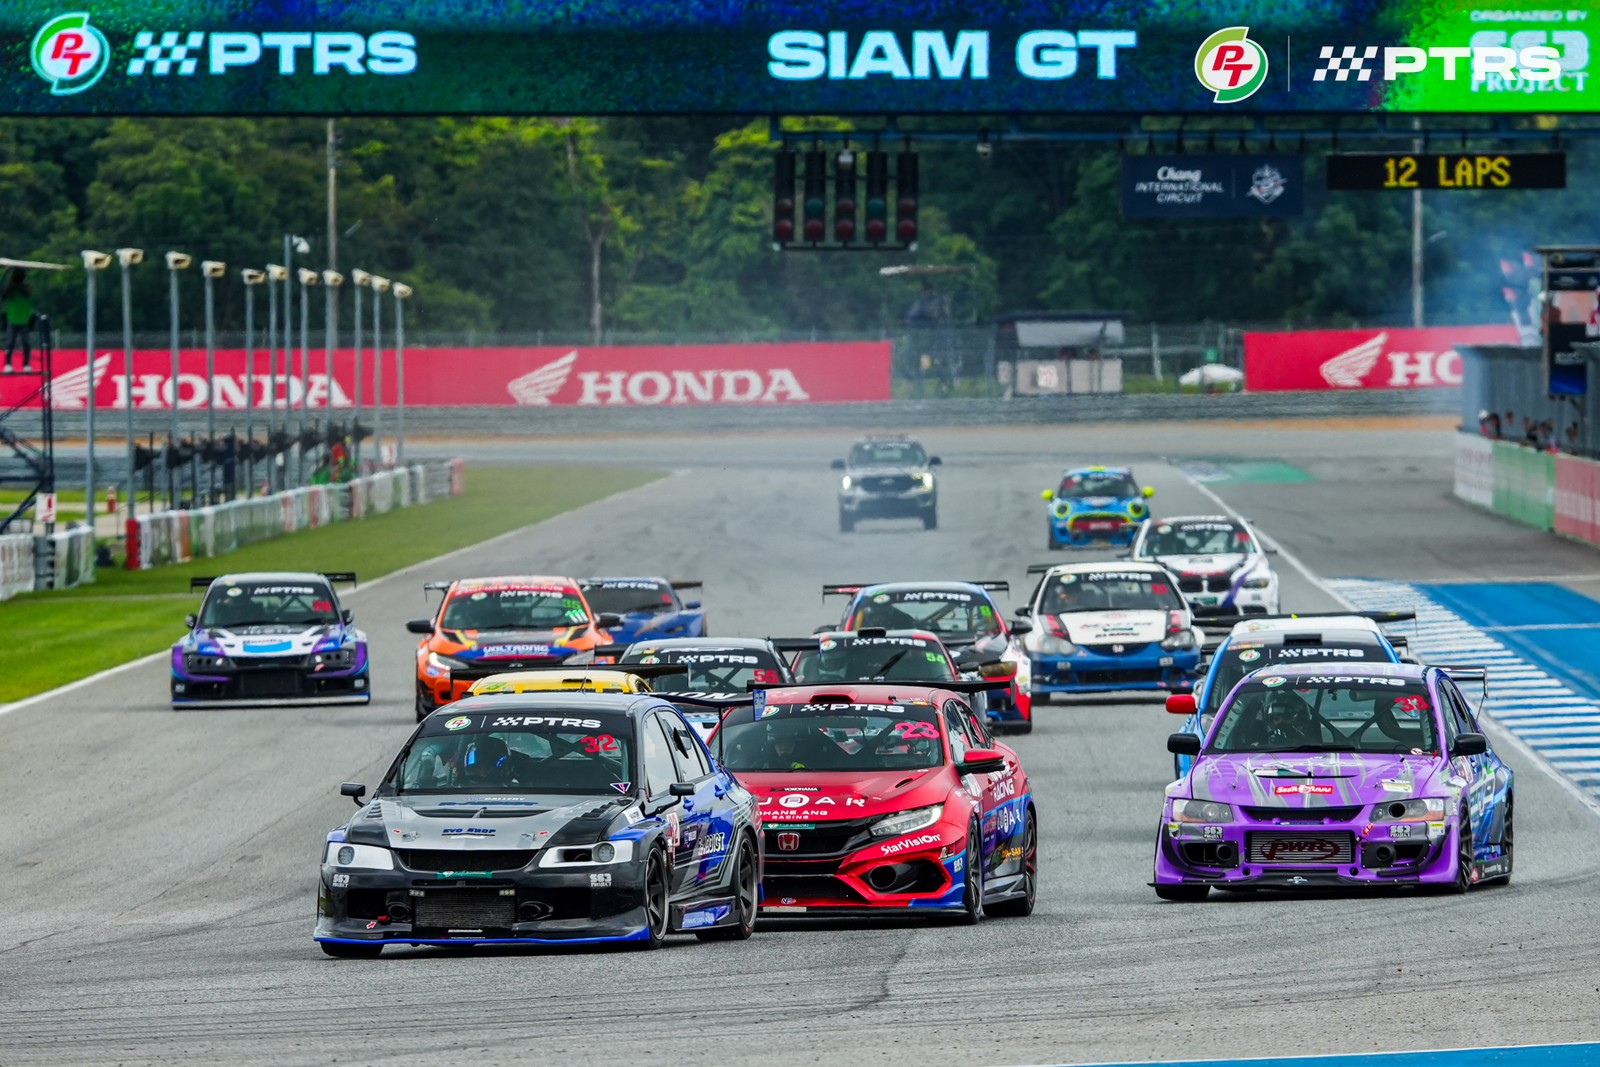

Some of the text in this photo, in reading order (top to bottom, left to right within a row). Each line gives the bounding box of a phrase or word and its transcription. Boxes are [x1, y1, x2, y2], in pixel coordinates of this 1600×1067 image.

[209, 31, 418, 76] PTRS
[767, 29, 1137, 80] SIAM GT
[1156, 165, 1202, 182] Chang
[1383, 156, 1511, 187] 12 LAPS
[1135, 182, 1224, 193] INTERNATIONAL
[1156, 193, 1203, 204] CIRCUIT
[111, 373, 352, 409] HONDA
[578, 369, 810, 405] HONDA
[270, 587, 315, 595] PTRS
[922, 591, 971, 601] PTRS
[872, 637, 927, 648] PTRS
[925, 652, 947, 664] 54
[1301, 648, 1365, 658] PTRS
[699, 654, 759, 665] PTRS
[1334, 676, 1406, 687] PTRS
[830, 703, 905, 713] PTRS
[522, 716, 602, 729] PTRS
[895, 721, 940, 739] 23
[580, 733, 618, 753] 32
